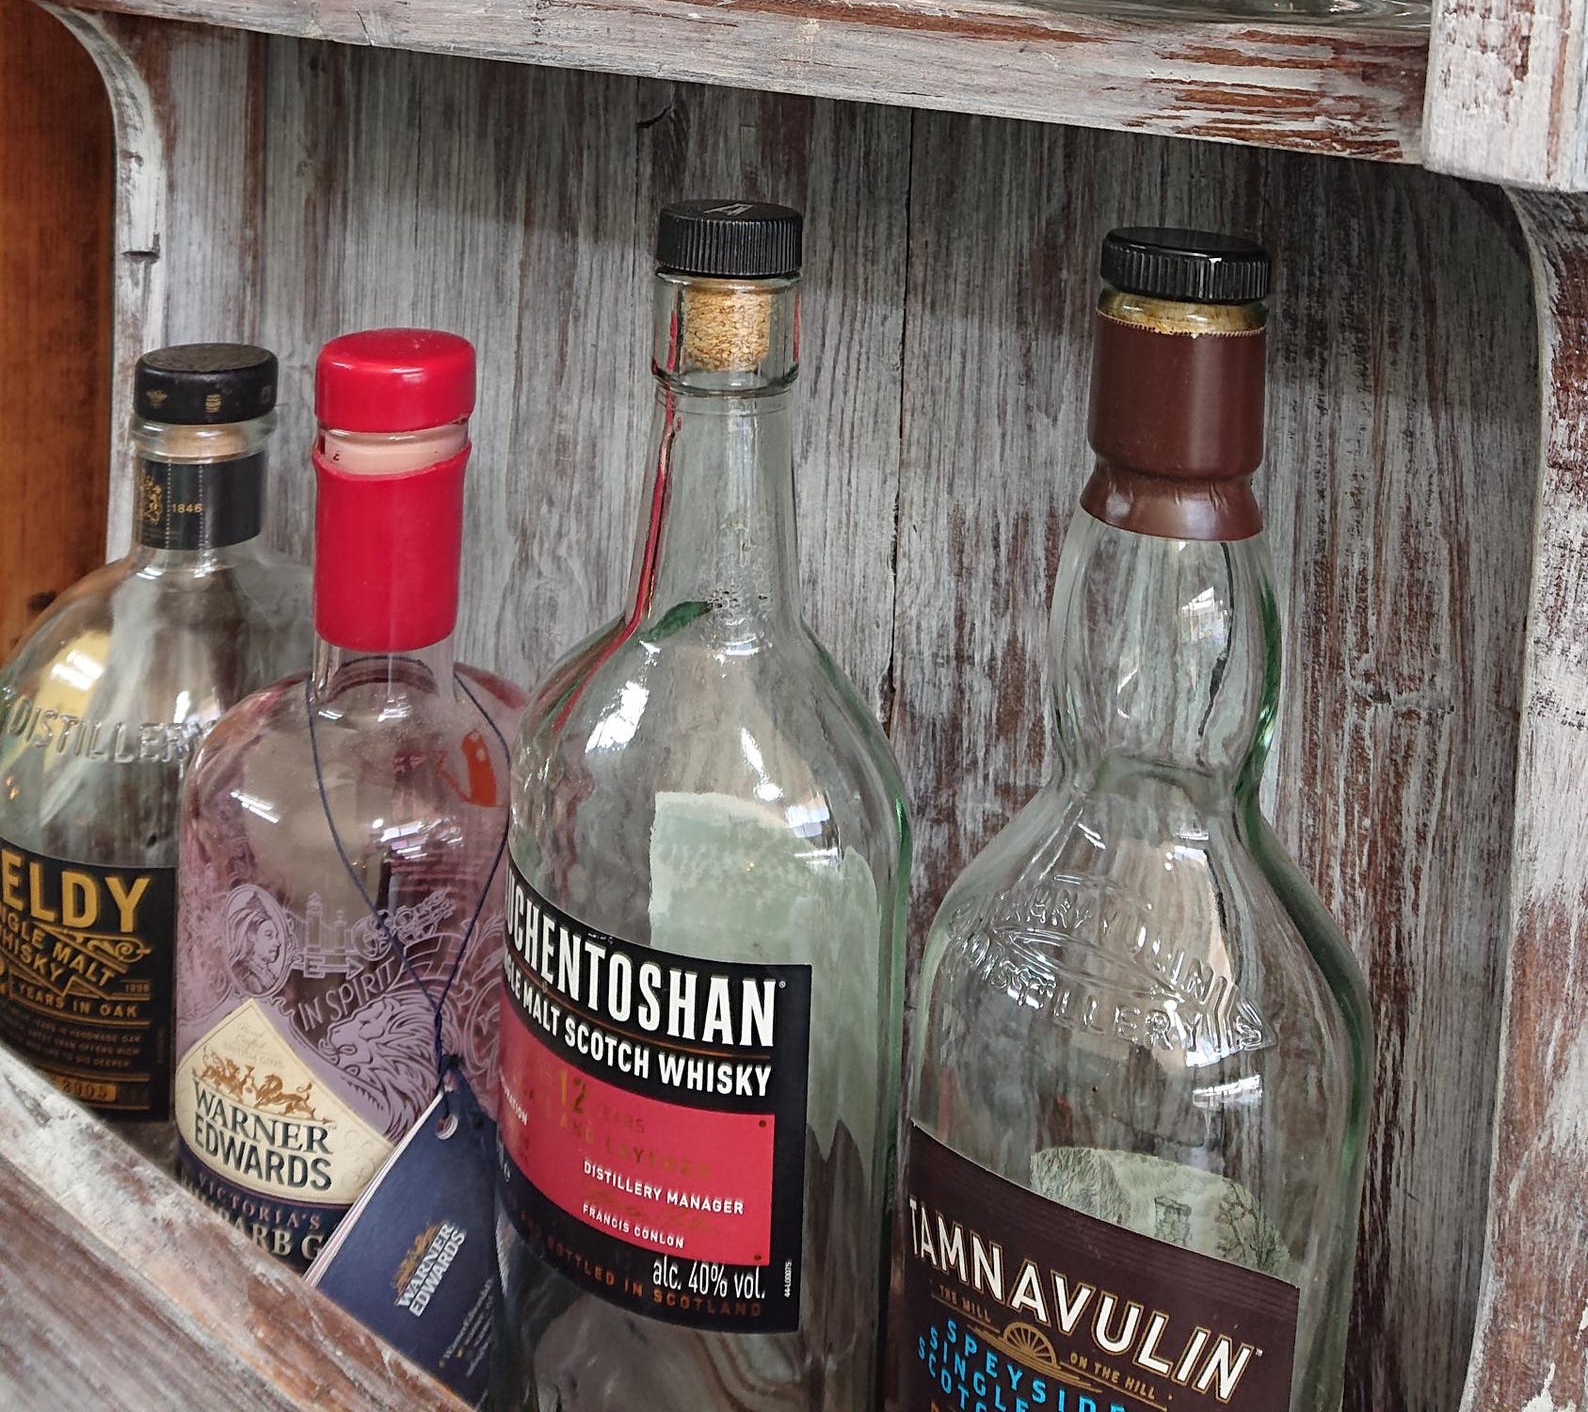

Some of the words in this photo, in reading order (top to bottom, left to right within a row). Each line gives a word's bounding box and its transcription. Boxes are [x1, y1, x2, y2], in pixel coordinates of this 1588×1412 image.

[172, 503, 202, 513] 1846
[52, 941, 116, 987] MALT
[506, 866, 776, 1048] UCHENTOSHAN
[100, 1003, 138, 1018] OAK
[325, 956, 396, 1022] SPIRIT
[523, 981, 560, 1037] MALT
[565, 1015, 650, 1080] SCOTCH
[658, 1052, 772, 1098] WHISKY
[193, 1077, 334, 1156] WARNER
[195, 1110, 333, 1193] EDWARDS
[584, 1159, 663, 1201] DISTILLERY
[667, 1189, 744, 1215] MANAGER
[583, 1203, 630, 1233] FRANCIS
[634, 1225, 684, 1249] CONLON
[398, 1222, 455, 1307] WARNER
[408, 1229, 466, 1317] EDWARDS
[653, 1254, 682, 1291] alc.
[688, 1260, 728, 1298] 40%
[734, 1265, 766, 1299] vol.
[653, 1288, 762, 1317] SCOTLAND
[909, 1197, 1254, 1404] TAMNAVULIN
[1070, 1352, 1088, 1369] ON
[1094, 1363, 1120, 1384] THE
[1124, 1376, 1156, 1400] HILL
